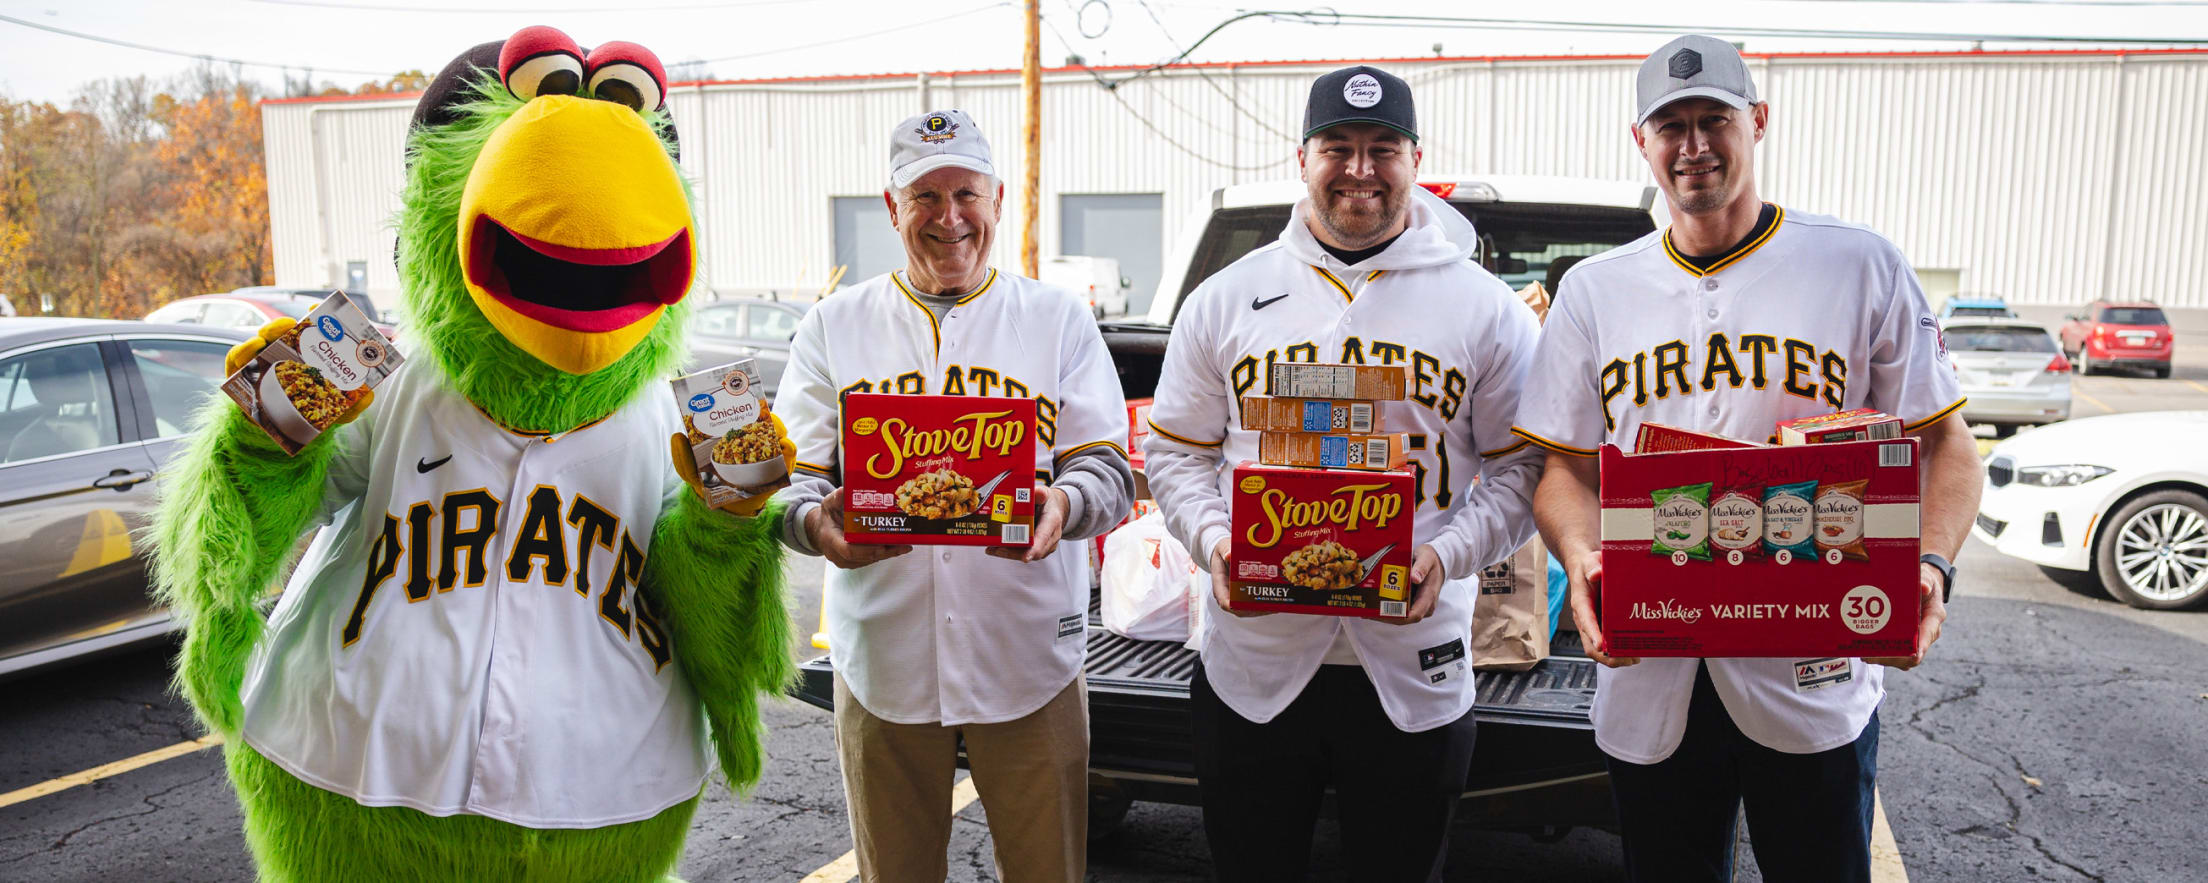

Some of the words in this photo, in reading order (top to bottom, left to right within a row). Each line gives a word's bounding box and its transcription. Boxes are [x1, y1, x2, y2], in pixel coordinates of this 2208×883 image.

[1351, 88, 1376, 99] Fancy
[931, 117, 942, 130] P
[318, 340, 357, 381] Chicken
[1600, 331, 1848, 434] PIRATES
[709, 402, 753, 421] Chicken
[997, 500, 1006, 510] 6
[860, 515, 908, 527] TURKEY
[1674, 553, 1685, 562] 10
[1731, 553, 1739, 562] 8
[1780, 552, 1787, 561] 6
[1830, 552, 1838, 561] 6
[1387, 571, 1399, 585] 6
[1246, 585, 1290, 598] TURKEY
[1710, 603, 1790, 619] VARIETY
[1795, 603, 1831, 619] MIX
[1847, 595, 1885, 618] 30
